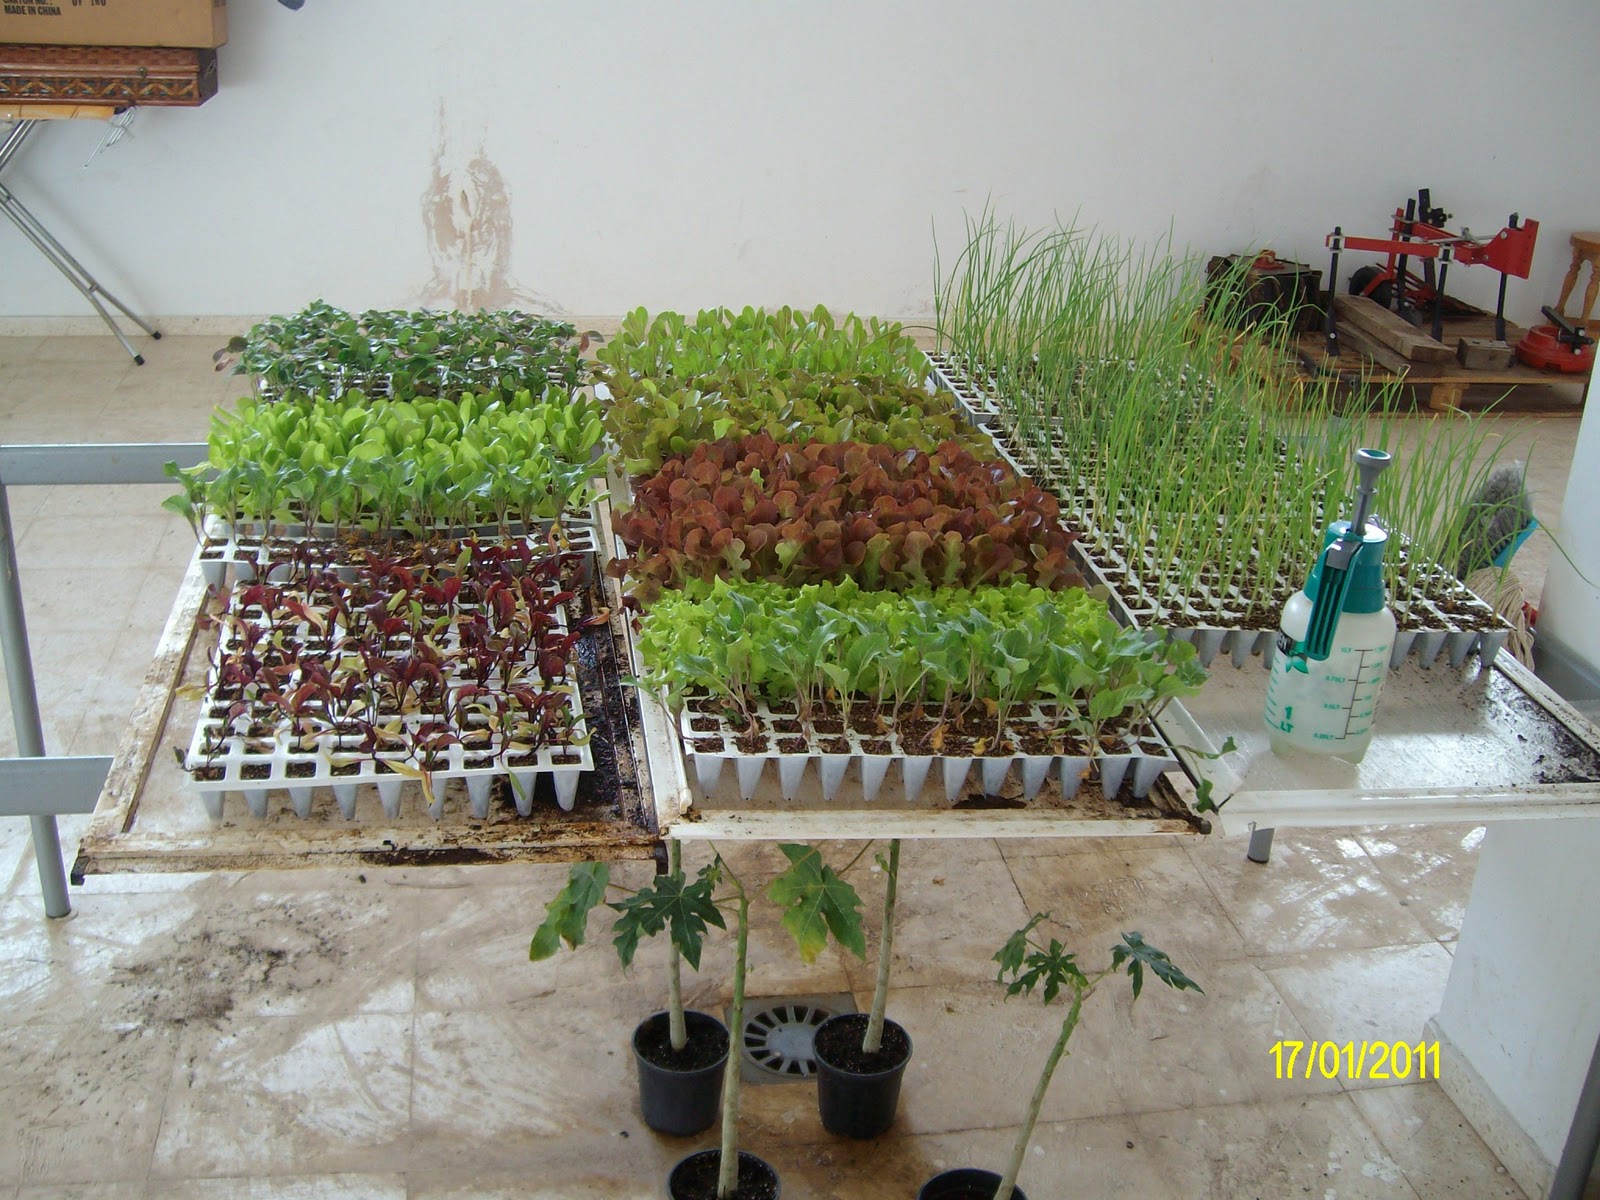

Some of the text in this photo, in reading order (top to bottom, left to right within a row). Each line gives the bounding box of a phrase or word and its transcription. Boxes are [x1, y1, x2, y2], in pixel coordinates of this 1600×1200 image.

[4, 5, 61, 16] MADE IN CHINA
[1285, 705, 1292, 720] 1
[1281, 721, 1294, 733] LT
